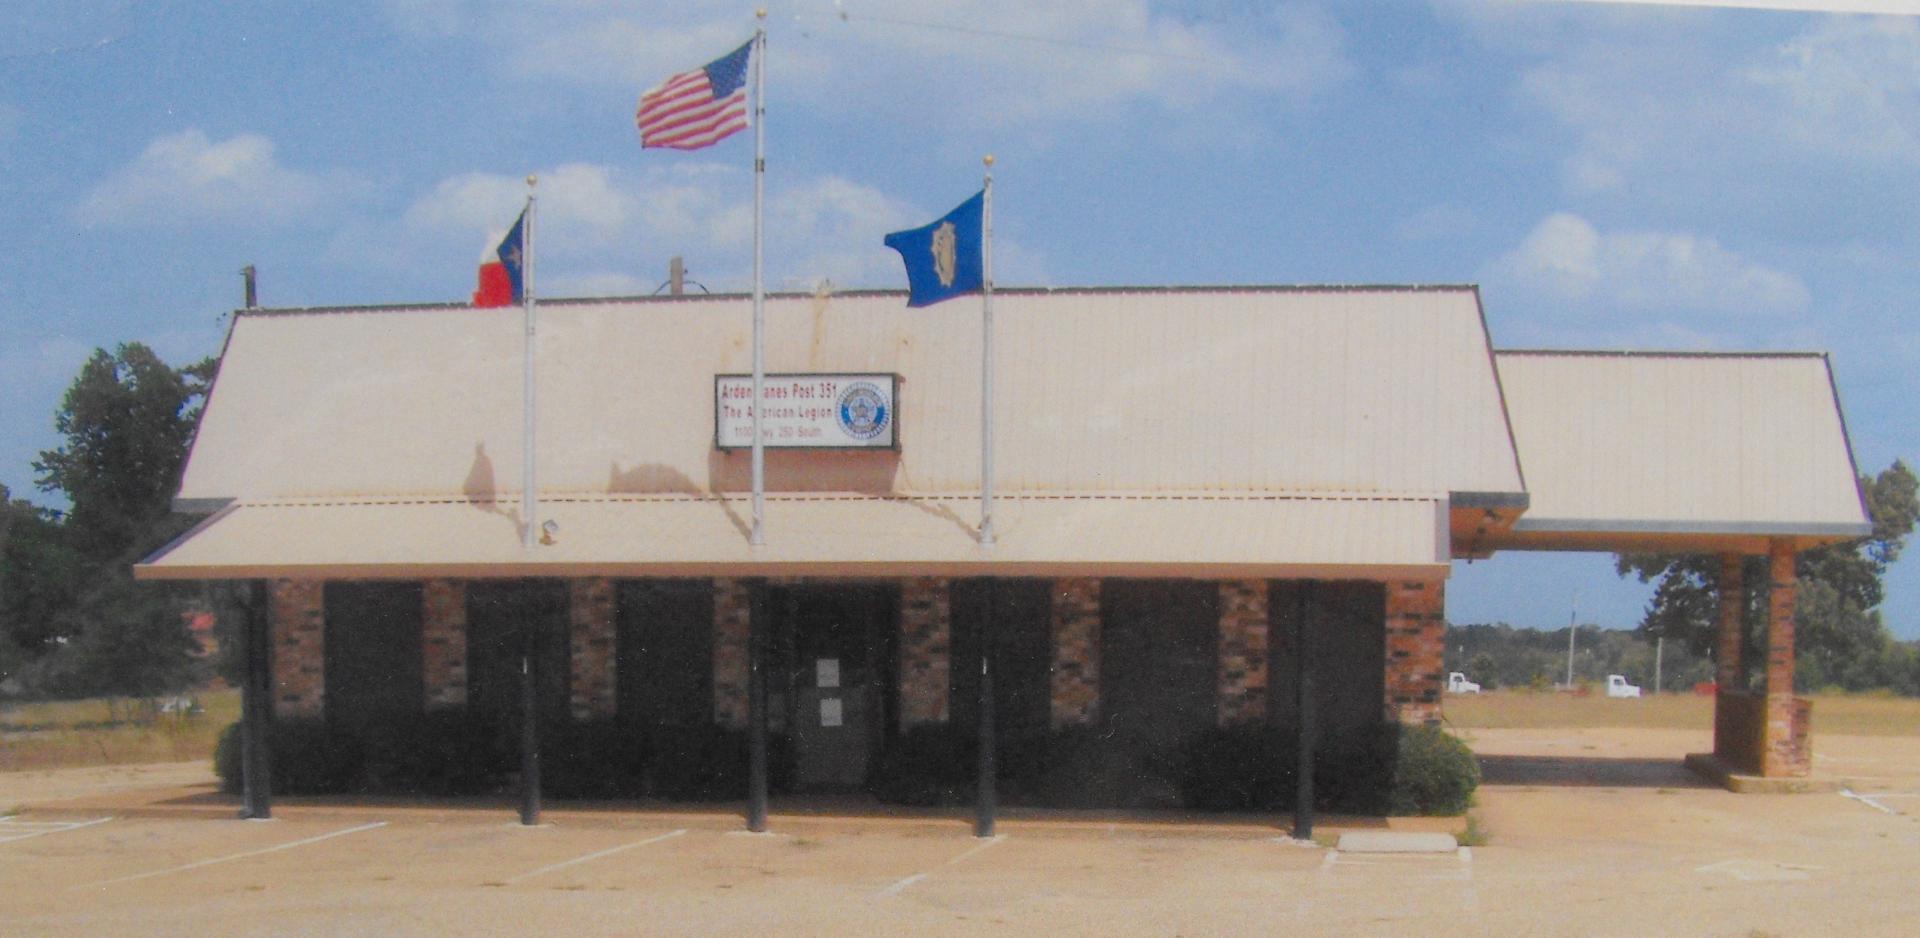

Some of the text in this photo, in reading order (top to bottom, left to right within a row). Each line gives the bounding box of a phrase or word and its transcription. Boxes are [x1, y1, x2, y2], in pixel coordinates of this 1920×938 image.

[721, 383, 753, 399] Arden
[759, 384, 787, 399] anes
[792, 383, 815, 399] Post
[819, 382, 836, 399] 351
[723, 405, 832, 421] The Aerican Legion
